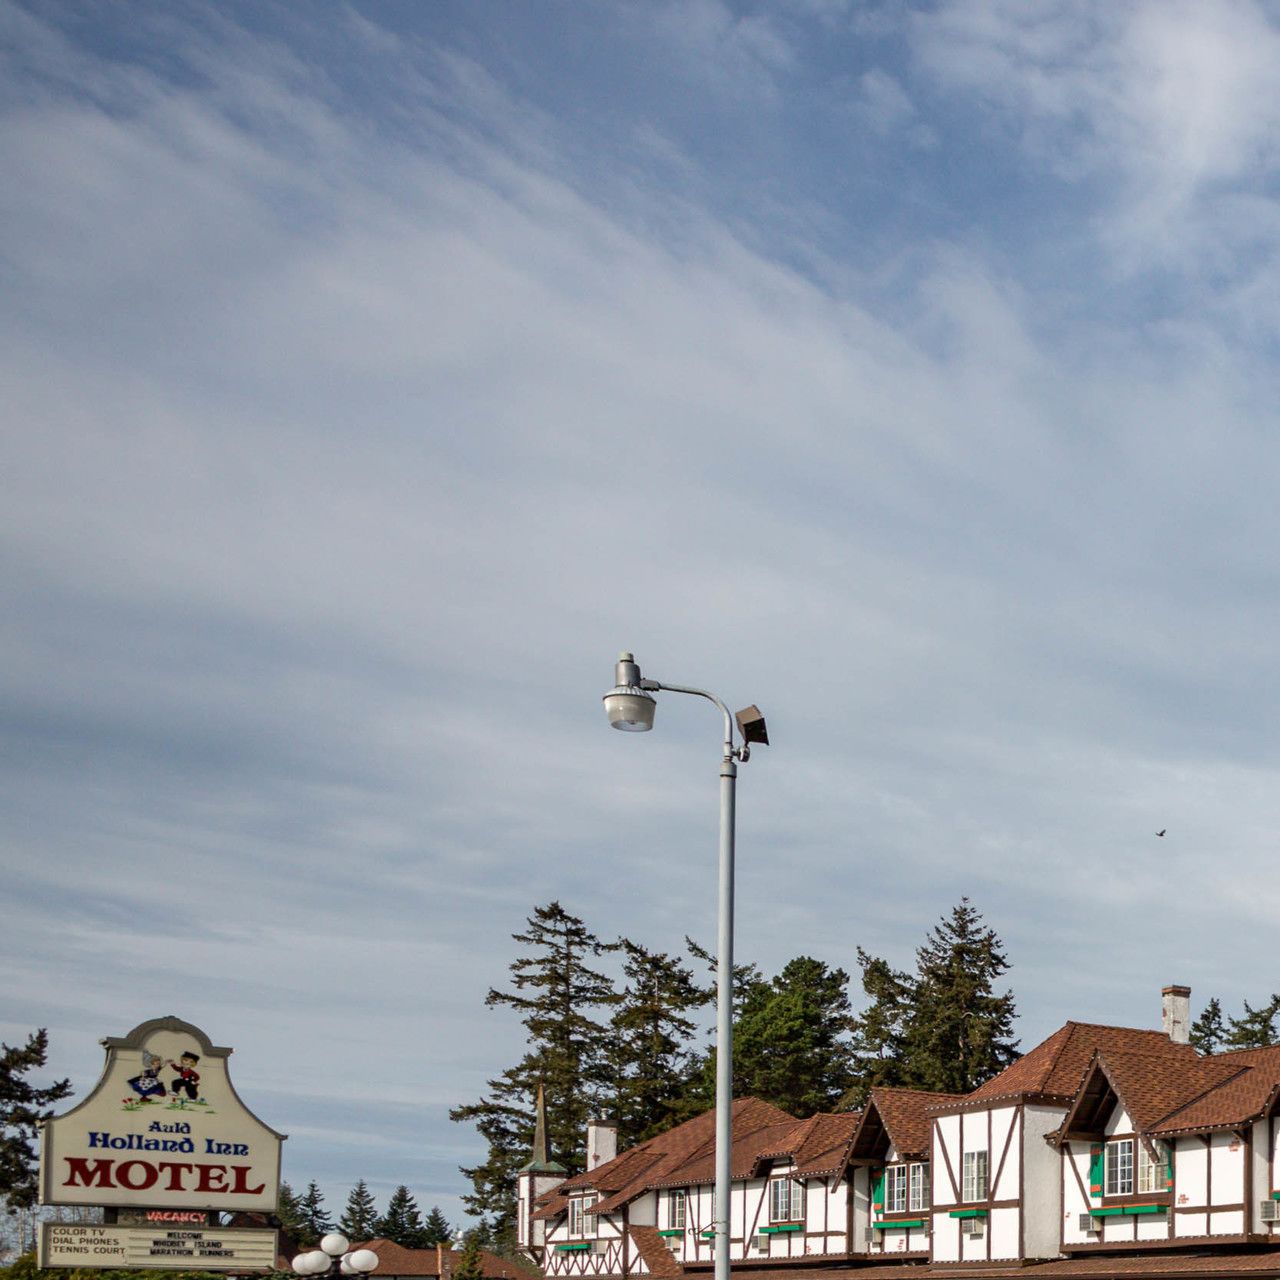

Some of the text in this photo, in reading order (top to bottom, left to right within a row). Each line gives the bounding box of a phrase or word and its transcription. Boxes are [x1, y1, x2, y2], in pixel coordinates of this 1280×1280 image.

[149, 1121, 191, 1135] Auld
[88, 1131, 249, 1156] Holland Inn
[62, 1157, 266, 1194] MOTEL
[146, 1210, 207, 1223] VACANCY
[52, 1228, 106, 1237] COLOR TV
[167, 1232, 203, 1240] WELCOME
[52, 1237, 120, 1246] DIAL PHONES
[52, 1246, 126, 1255] TENNIS COURT
[198, 1250, 235, 1258] RUNNERS
